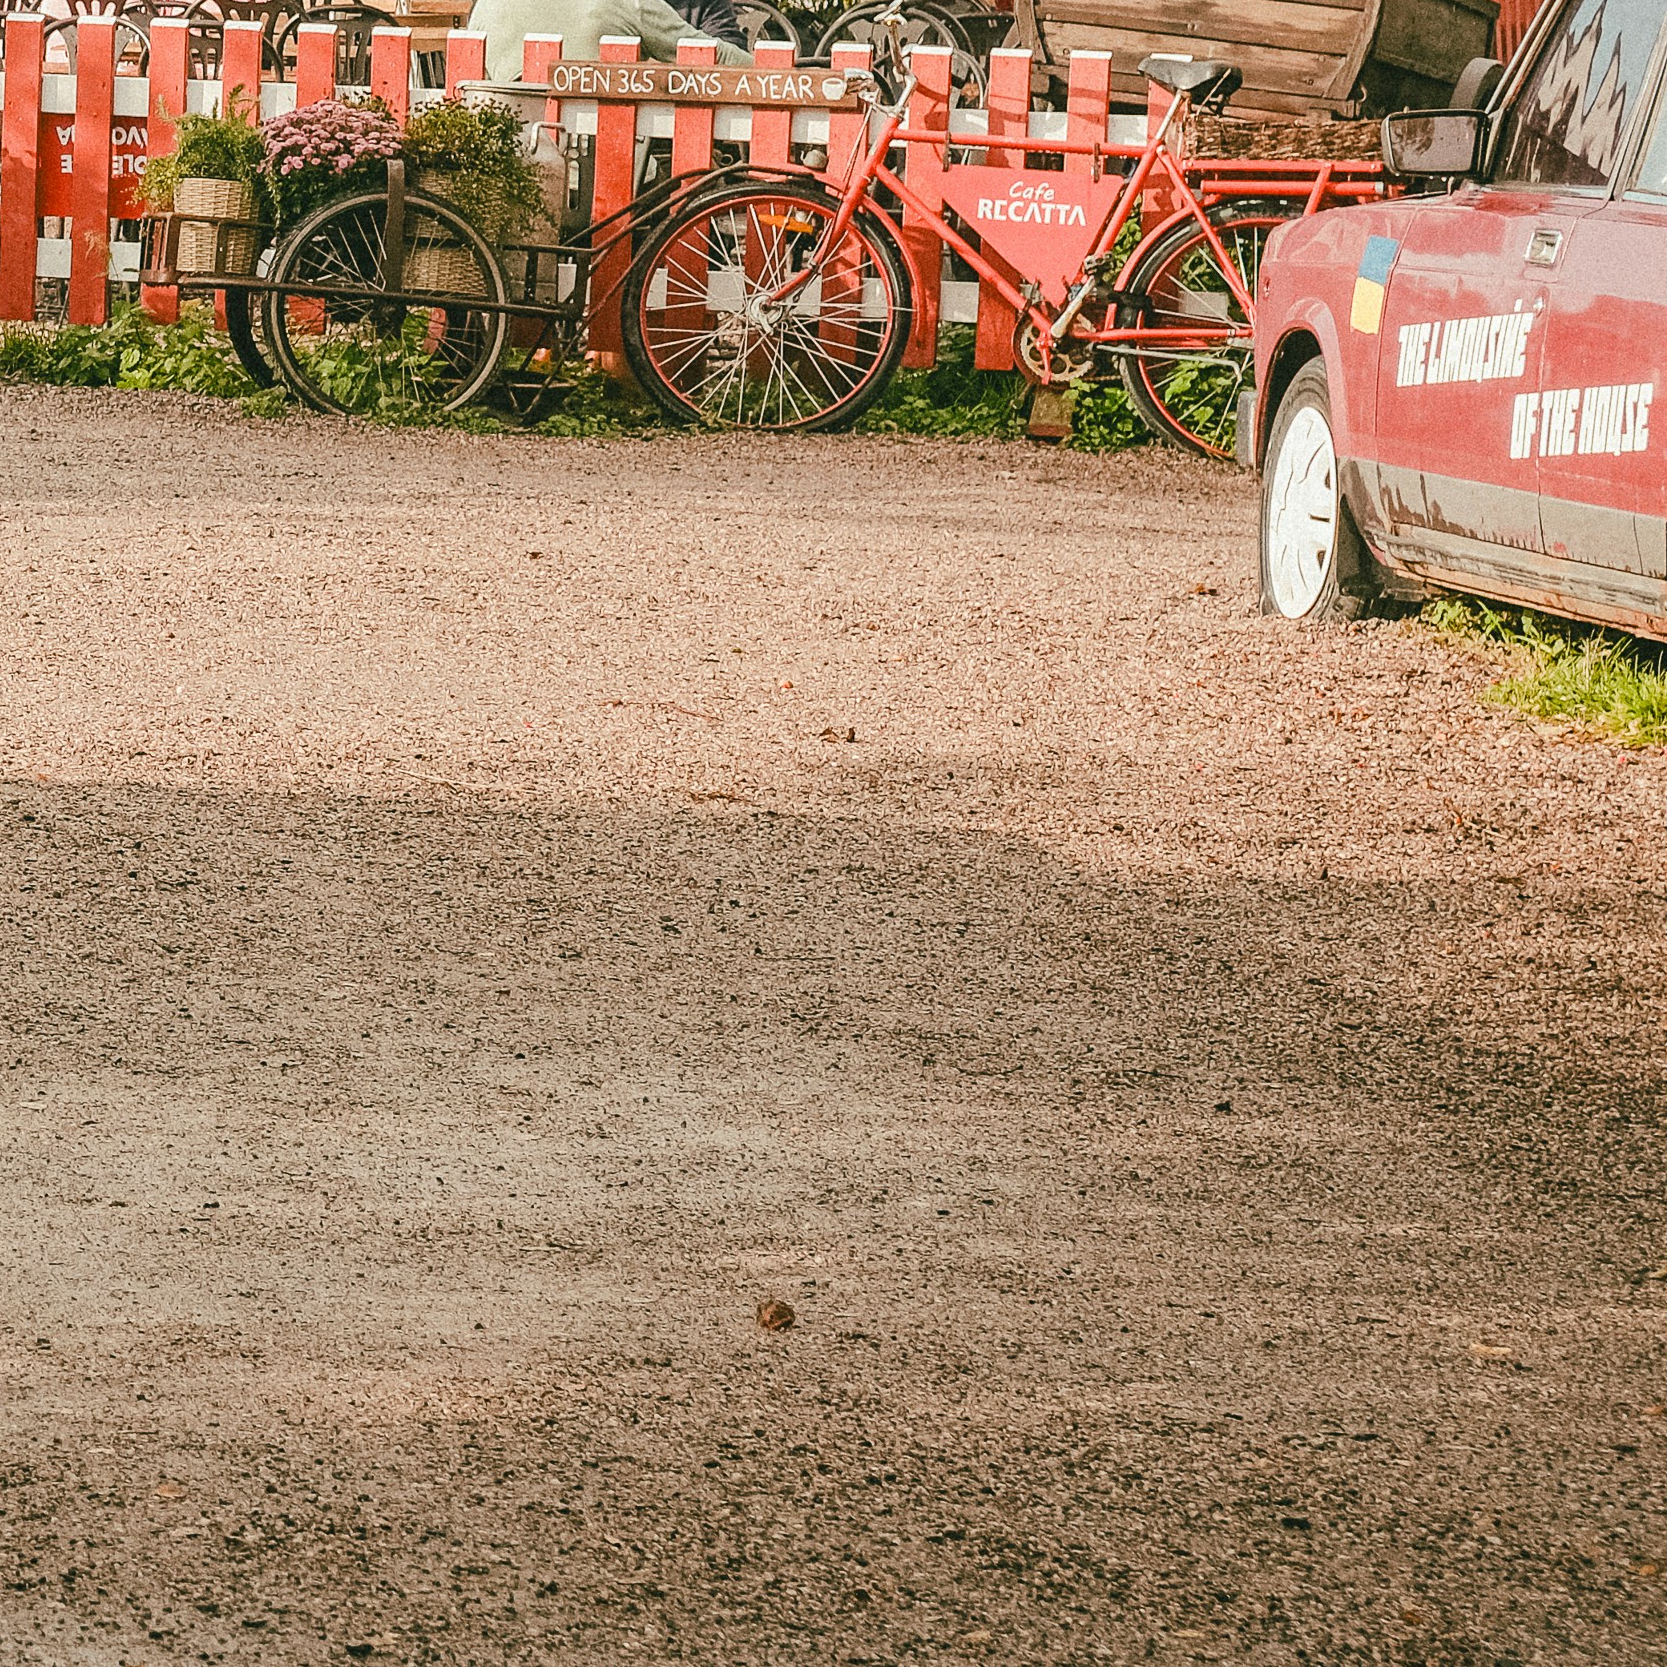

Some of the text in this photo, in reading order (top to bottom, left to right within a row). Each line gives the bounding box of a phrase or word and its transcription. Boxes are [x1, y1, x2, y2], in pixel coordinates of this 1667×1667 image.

[553, 65, 815, 100] OPEN 365 DAYS A YEAR
[1008, 180, 1055, 201] Cafe
[1396, 320, 1433, 388] THE
[1510, 382, 1654, 460] OF THE HOUSE
